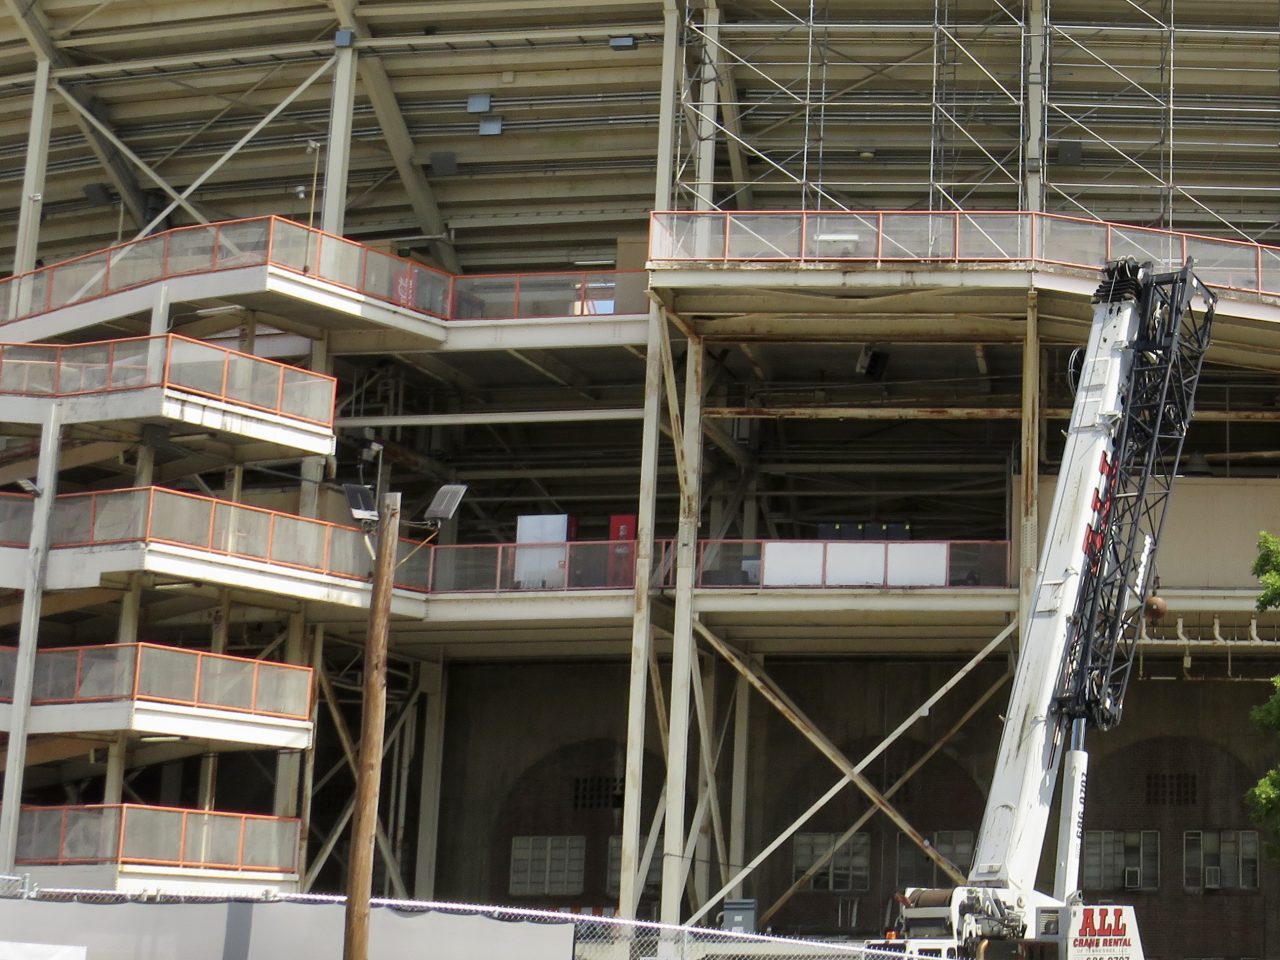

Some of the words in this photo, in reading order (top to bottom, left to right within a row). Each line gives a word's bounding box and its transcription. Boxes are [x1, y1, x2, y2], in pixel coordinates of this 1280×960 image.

[1079, 908, 1126, 936] ALL
[1073, 938, 1100, 948] CRANE
[1102, 938, 1131, 947] RENTAL
